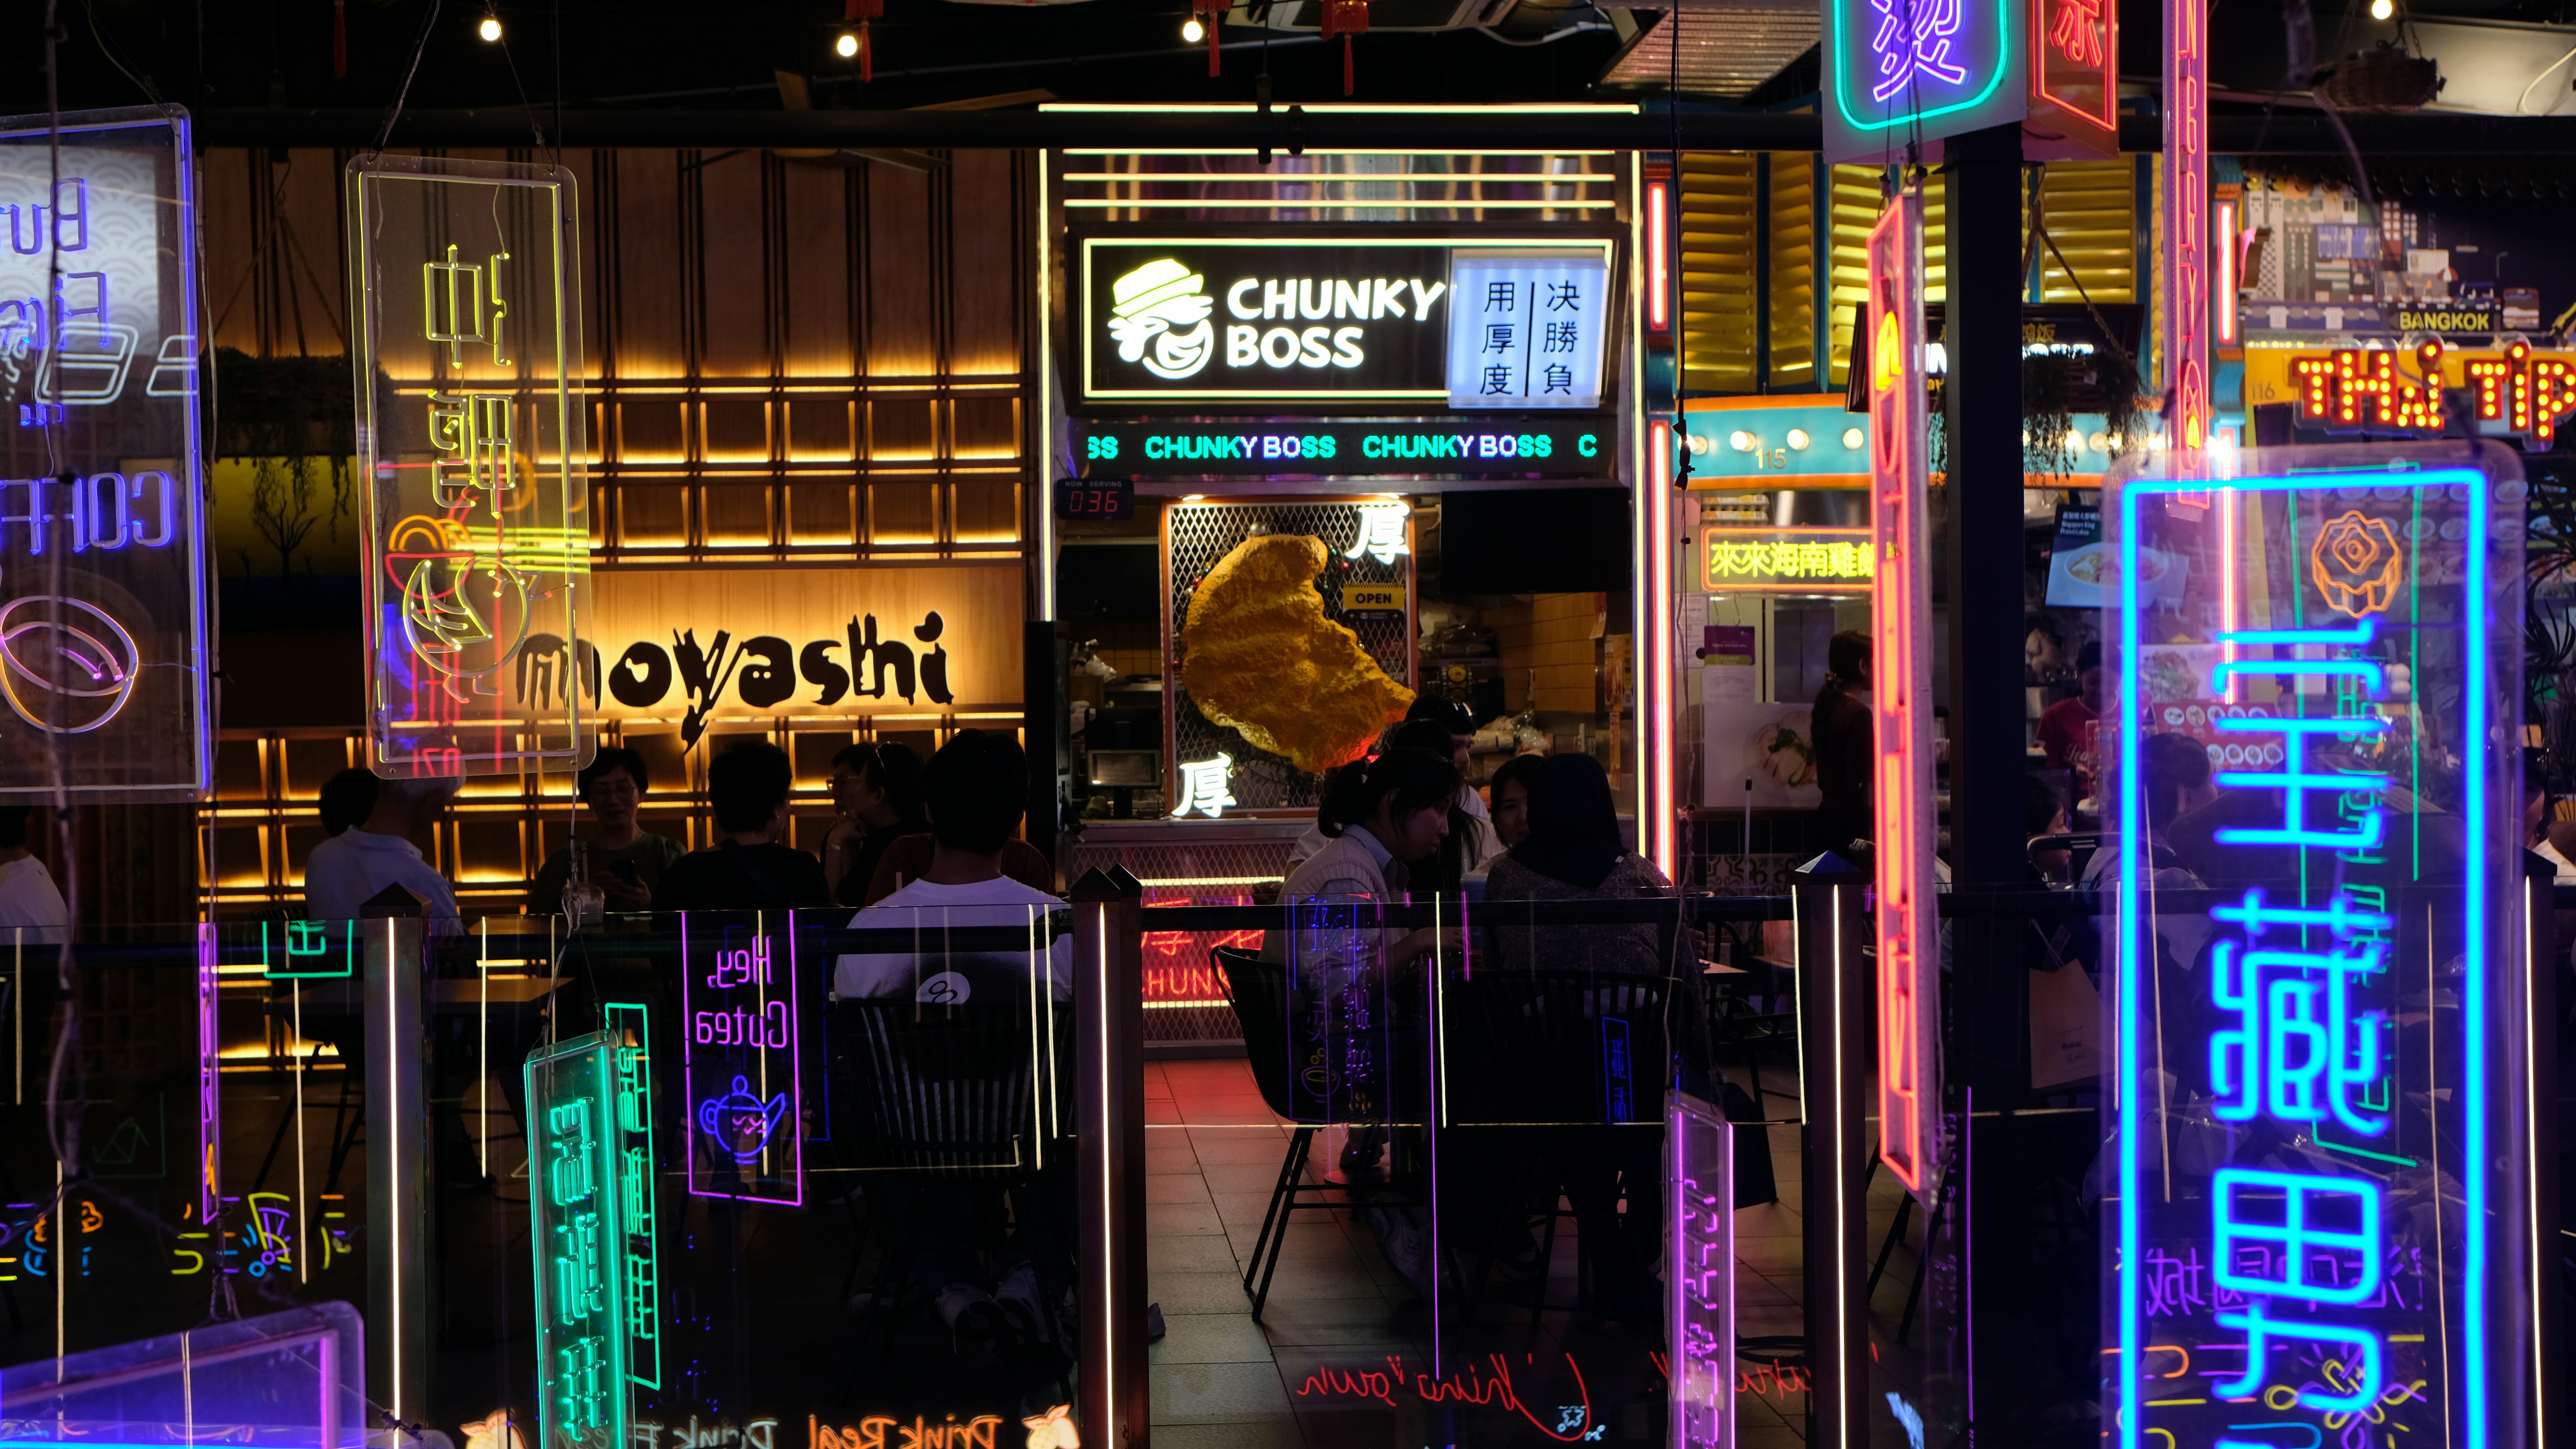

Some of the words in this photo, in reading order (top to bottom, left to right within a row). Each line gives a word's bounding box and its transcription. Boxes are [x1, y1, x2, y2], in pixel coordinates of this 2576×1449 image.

[1227, 278, 1446, 321] CHUNKY
[1479, 281, 1515, 395] 用厚度
[2399, 311, 2489, 331] BANGKOK
[1227, 325, 1364, 368] BOSS
[2251, 382, 2275, 400] 116
[1145, 436, 1258, 459] CHUNKY
[1263, 435, 1336, 459] BOSS
[1363, 434, 1474, 458] CHUNKY
[1479, 434, 1552, 458] BOSS
[1578, 434, 1597, 457] C
[1756, 448, 1787, 470] 115
[1069, 490, 1118, 513] 036
[1345, 492, 1410, 565] 厚
[1355, 593, 1392, 604] OPEN
[516, 610, 954, 755] moyashi
[1171, 751, 1237, 818] 厚
